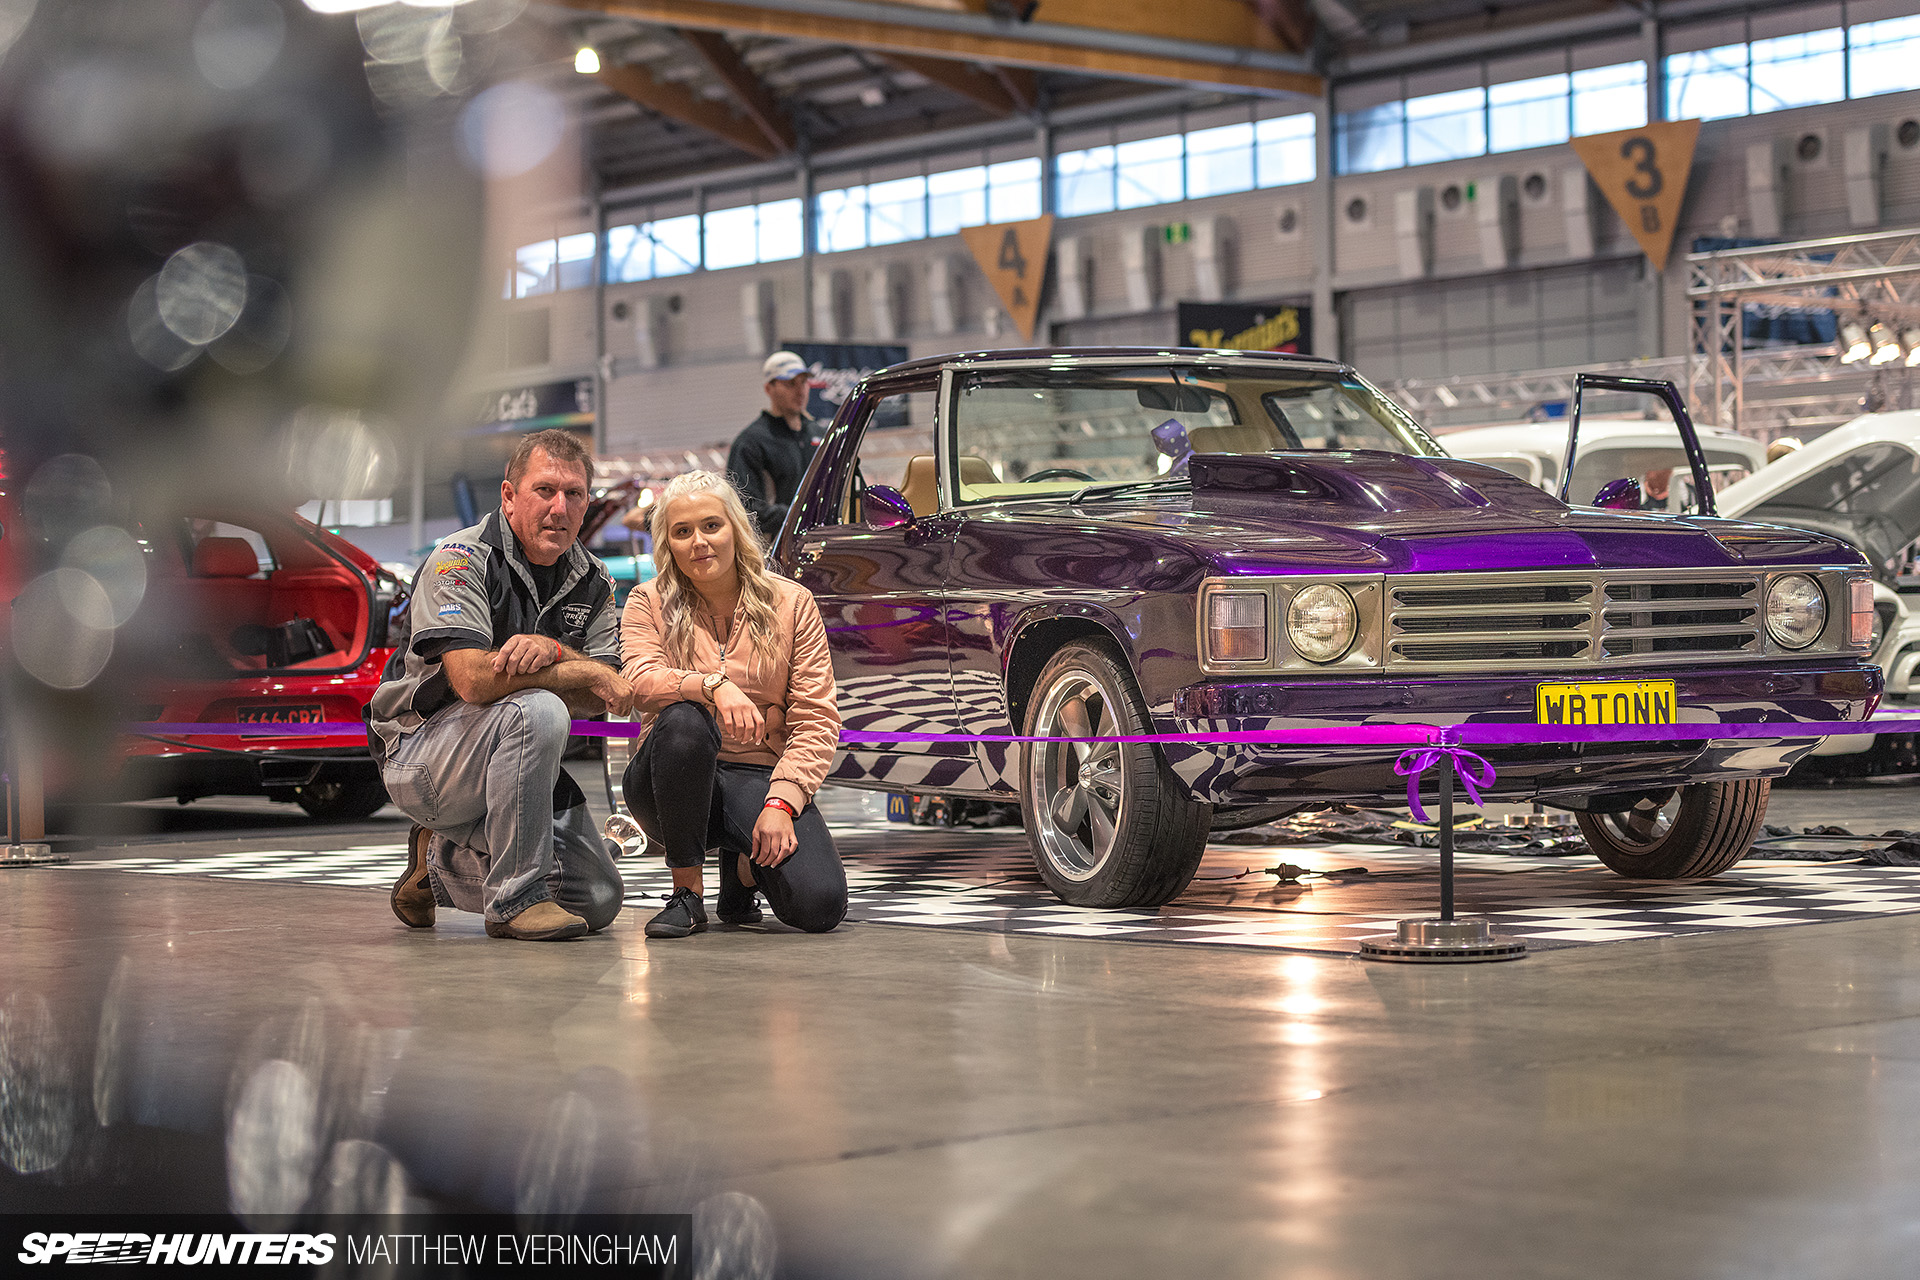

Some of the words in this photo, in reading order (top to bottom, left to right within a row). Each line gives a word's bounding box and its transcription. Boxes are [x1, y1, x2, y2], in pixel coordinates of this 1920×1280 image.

[1620, 136, 1664, 199] 3
[998, 228, 1027, 280] 4
[1544, 690, 1670, 725] WBTONN
